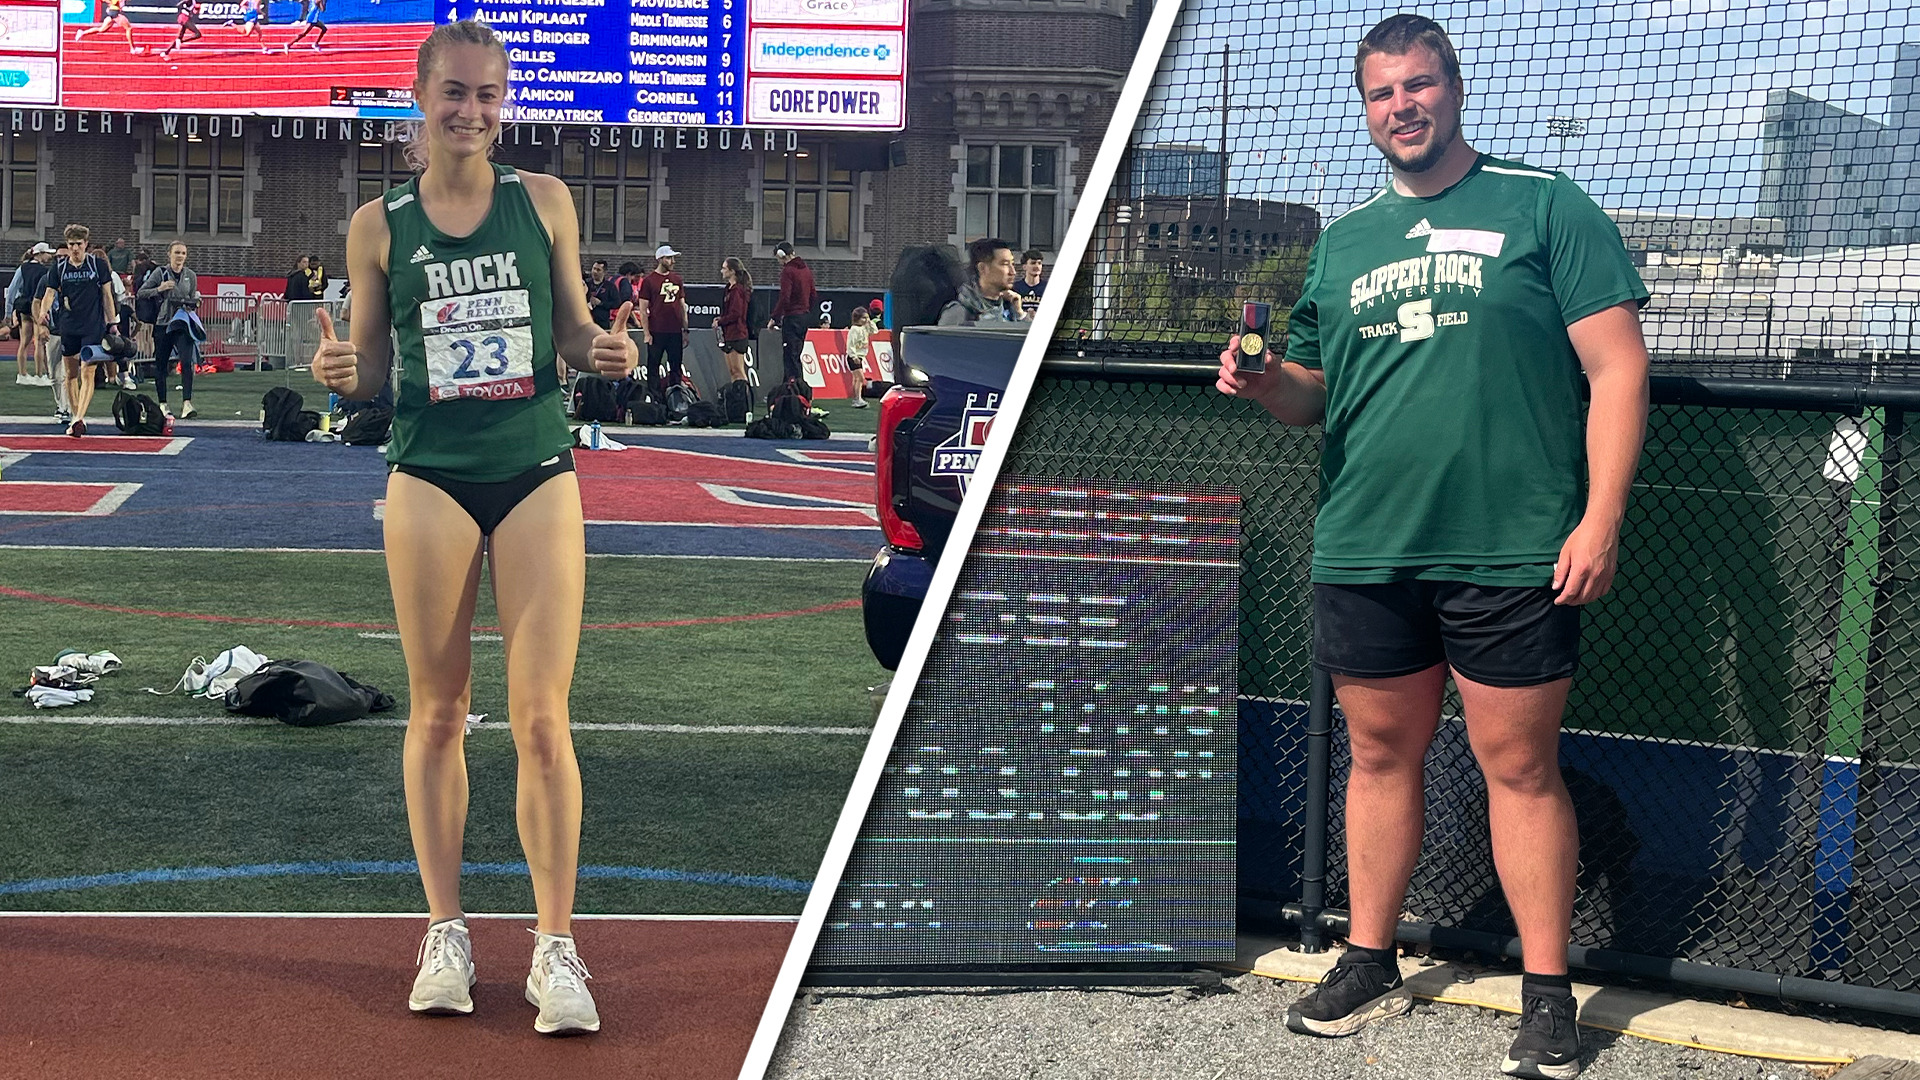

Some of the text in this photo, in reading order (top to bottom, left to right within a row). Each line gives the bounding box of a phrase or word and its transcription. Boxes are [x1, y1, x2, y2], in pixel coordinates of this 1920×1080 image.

[723, 0, 733, 10] 5
[806, 0, 849, 10] Grace
[447, 7, 732, 29] 4 ALLAN KIPLAGAT MIDDLE TENNESSEE 6
[493, 29, 732, 48] OMAS BRIDGER BIRMINGHAM 7
[509, 48, 731, 67] GILLES WISCONSIN 9
[762, 42, 870, 58] Independence
[507, 68, 735, 87] ELO CANNIZZARO MIDDLE TENNESSEE 10
[519, 86, 574, 102] AMICON
[636, 89, 698, 105] CORNELL
[717, 91, 733, 106] 11
[769, 89, 880, 115] CORE POWER
[516, 105, 603, 122] KIRKPATRICK
[627, 108, 706, 124] GEORGETOWN
[716, 110, 733, 125] 13
[11, 109, 135, 135] ROBERT
[161, 113, 244, 138] WOOD
[271, 117, 420, 142] JOHNSON
[589, 126, 799, 151] SCOREBOARD
[424, 251, 521, 300] ROCK
[1350, 253, 1484, 309] SLIPPERY ROCK
[467, 296, 503, 309] PENN
[1352, 284, 1483, 316] UNIVERSITY
[465, 305, 515, 319] RELAYS
[1358, 298, 1469, 344] TRACK S FIELD
[450, 336, 509, 379] 23
[820, 353, 872, 374] TOYA
[463, 382, 523, 398] TOYOTA
[937, 453, 980, 470] PEN
